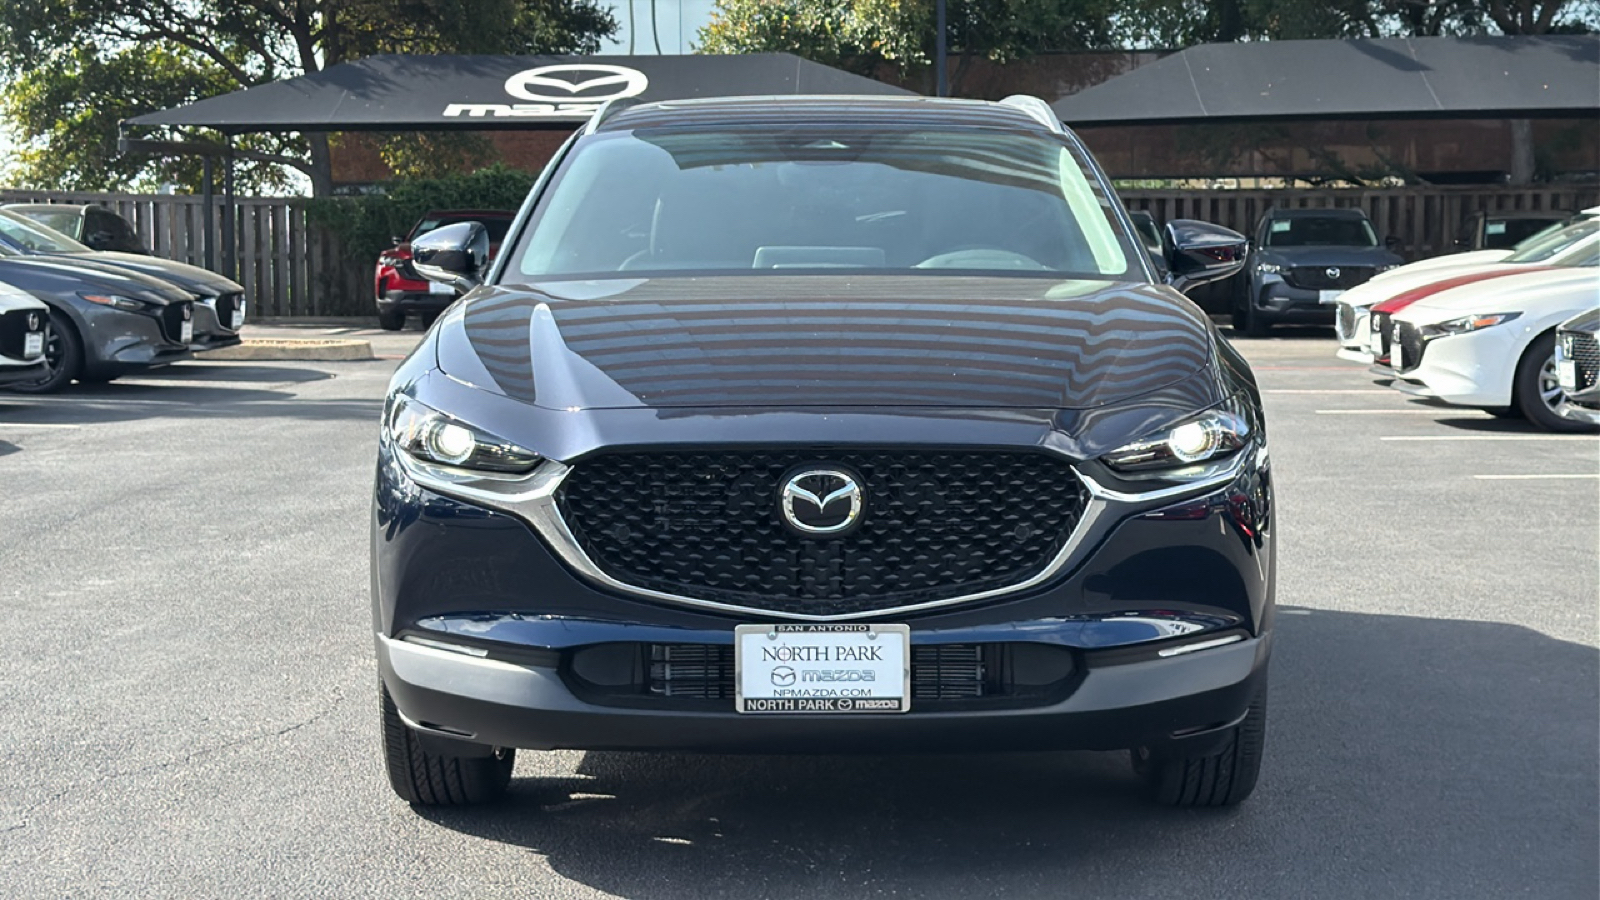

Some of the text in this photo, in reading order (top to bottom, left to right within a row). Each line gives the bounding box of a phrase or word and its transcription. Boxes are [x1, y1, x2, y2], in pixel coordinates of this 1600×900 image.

[443, 103, 602, 116] maz
[762, 645, 883, 662] NORTH PARK
[801, 669, 875, 682] mazda
[773, 688, 871, 697] NPMAZDA.COM
[748, 699, 899, 711] NORTH PARK mazda
